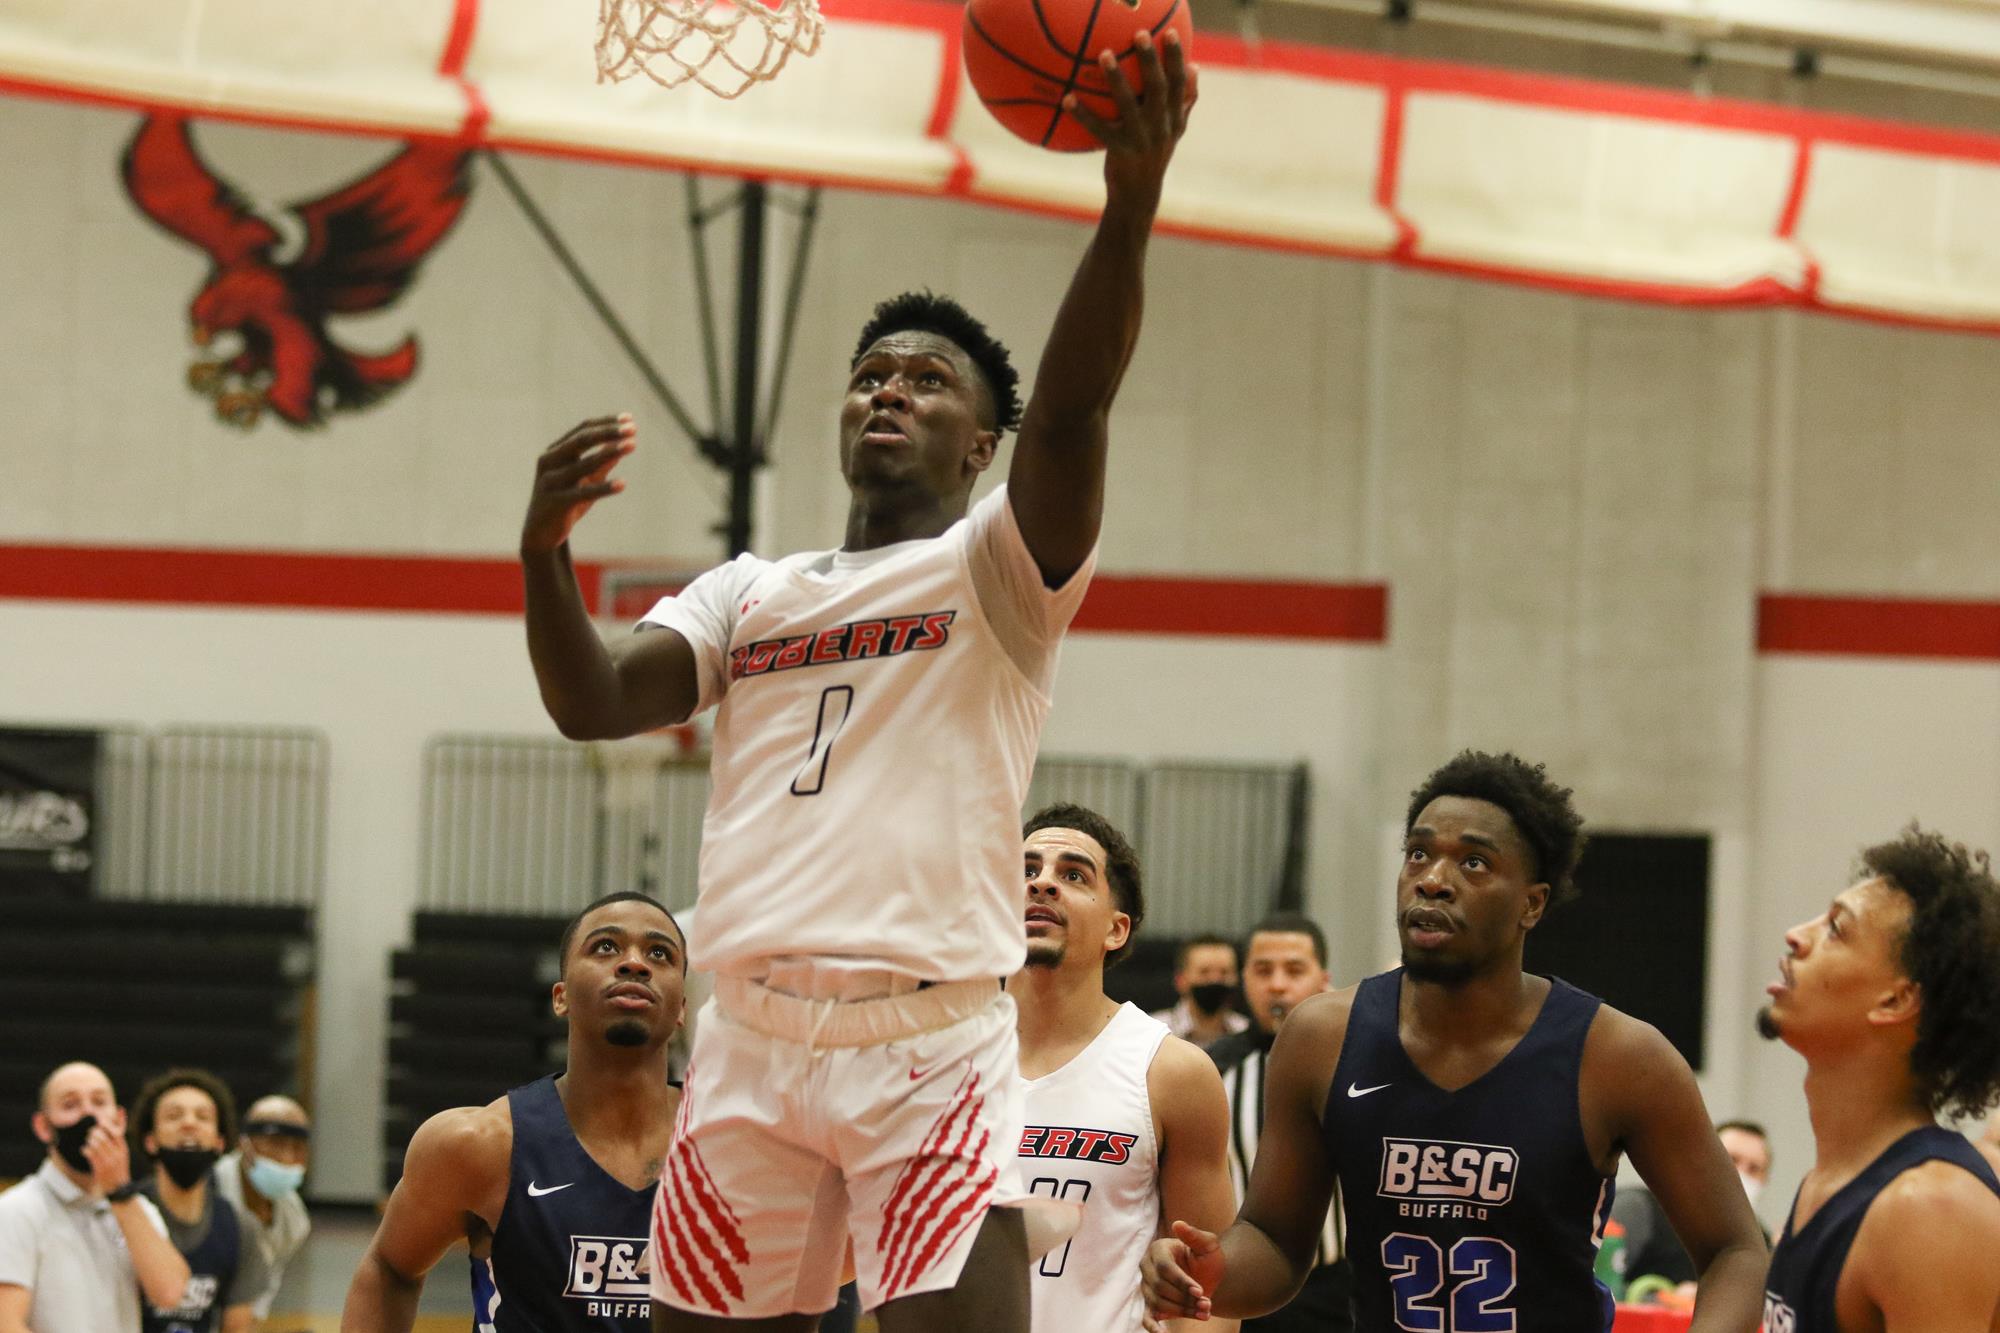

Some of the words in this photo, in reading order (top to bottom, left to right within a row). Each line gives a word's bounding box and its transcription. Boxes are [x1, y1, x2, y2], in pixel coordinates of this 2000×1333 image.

[731, 611, 956, 680] ROBERTS
[1018, 1126, 1138, 1165] ERTS
[1384, 1142, 1513, 1201] B&SC
[1399, 1203, 1488, 1221] BUFFALO
[571, 1241, 650, 1294] B&
[1380, 1231, 1517, 1333] 22
[587, 1302, 650, 1319] BUFFA
